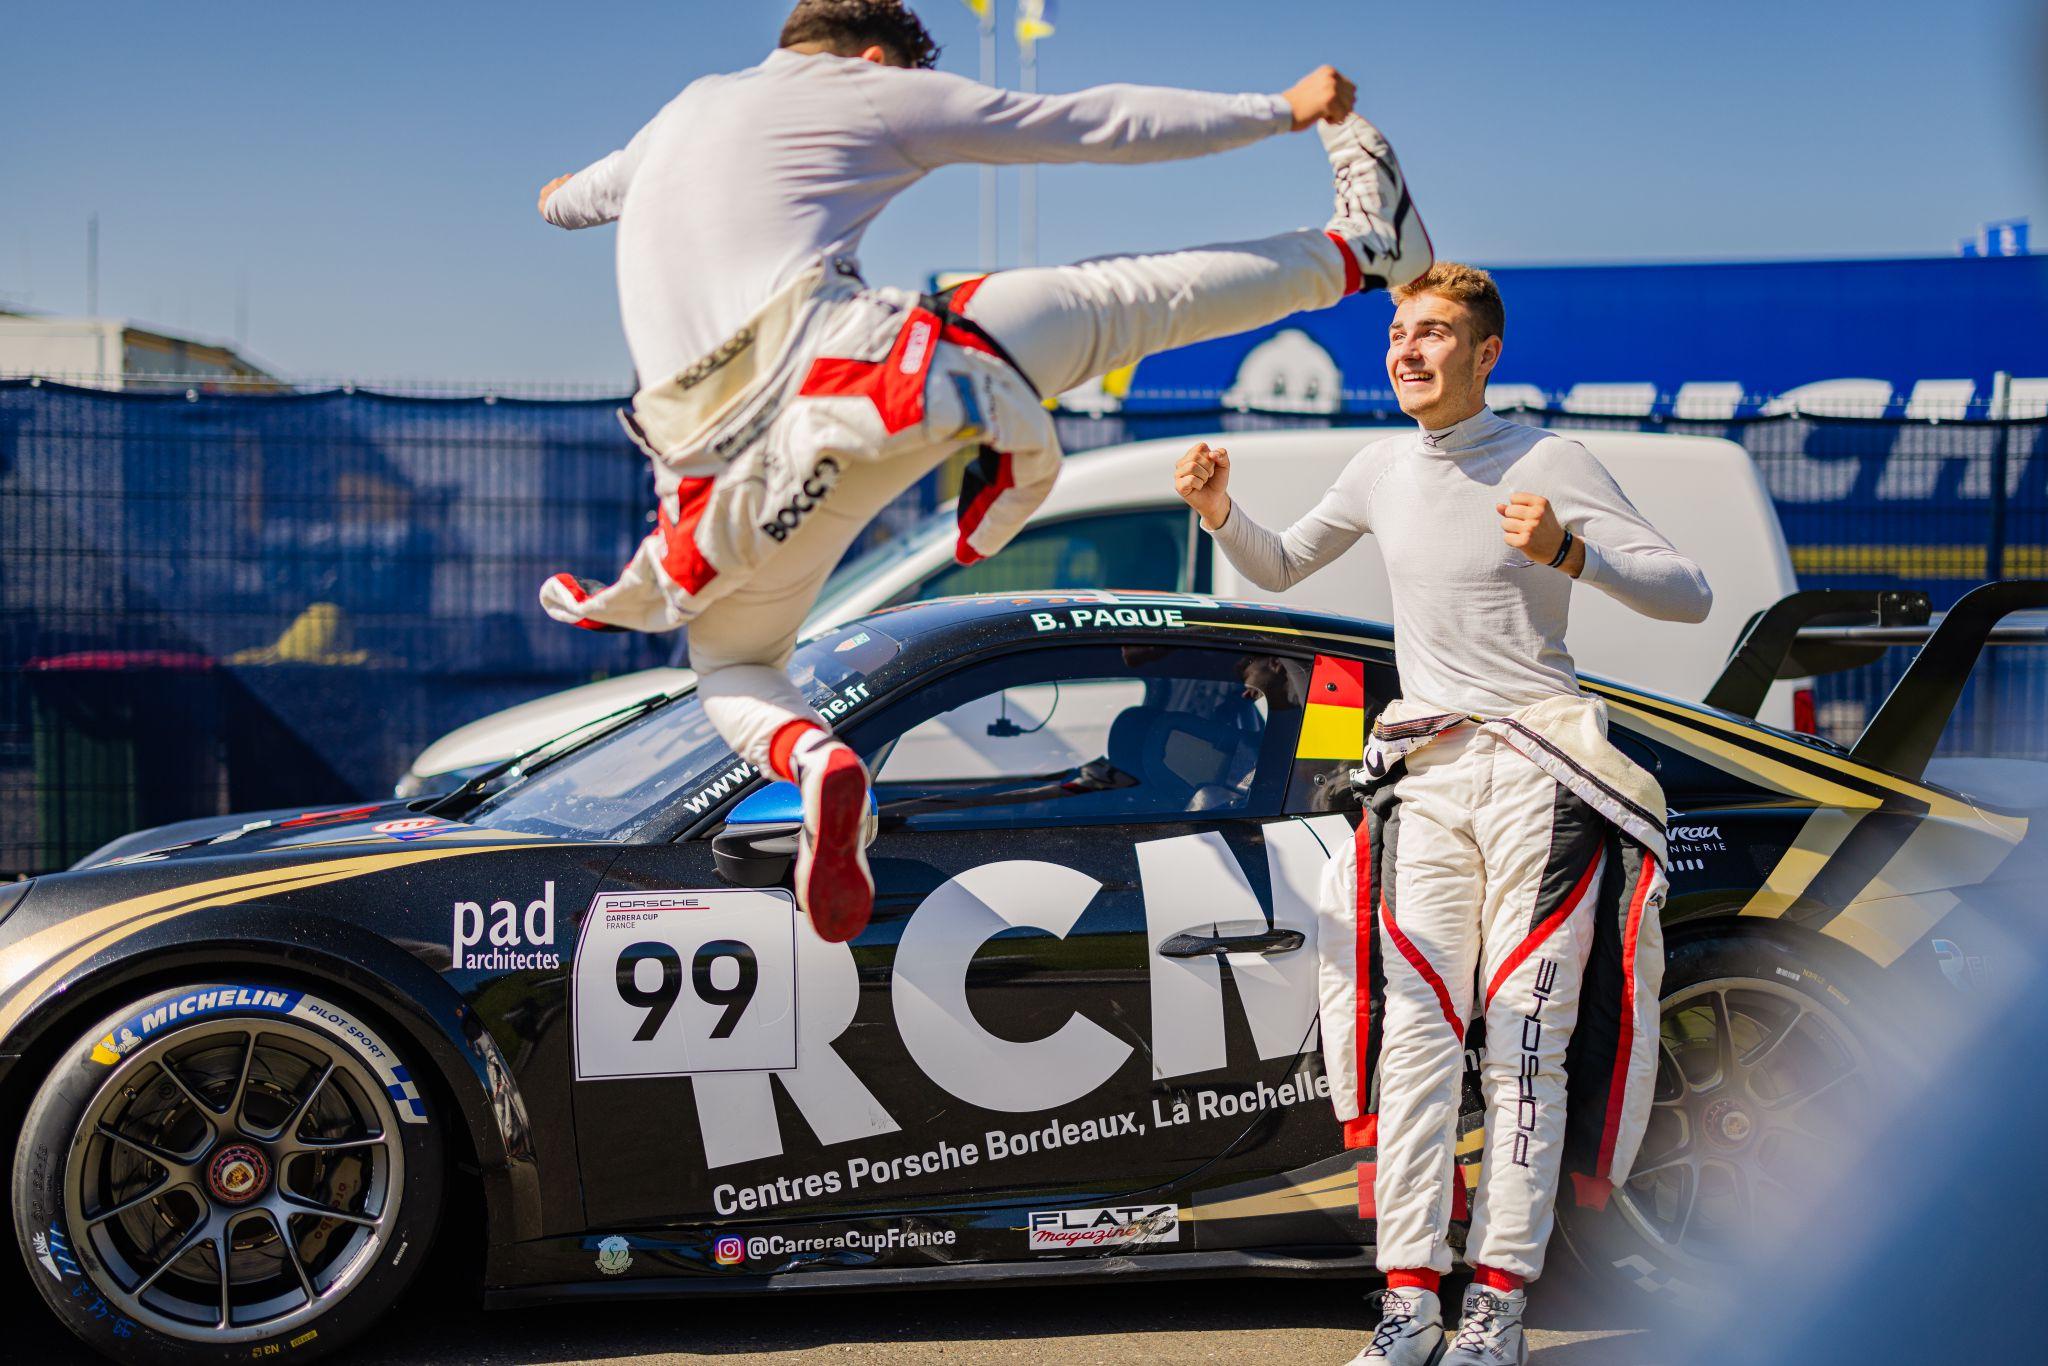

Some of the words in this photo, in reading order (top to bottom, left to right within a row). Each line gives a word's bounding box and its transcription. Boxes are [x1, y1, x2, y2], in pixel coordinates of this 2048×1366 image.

[1030, 612, 1066, 632] B.
[1071, 608, 1186, 629] PAQUE
[605, 899, 699, 909] PORSCHE
[606, 914, 642, 922] CARRERA
[642, 913, 659, 921] CUP
[453, 880, 555, 969] pad
[606, 922, 636, 930] FRANCE
[466, 947, 560, 970] architectes
[615, 938, 760, 1042] 99
[141, 988, 289, 1034] MICHELIN
[308, 1004, 344, 1027] PILOT
[348, 1025, 387, 1060] SPORT
[1512, 957, 1558, 1168] PORSCHE
[712, 1169, 842, 1216] Centres
[847, 1141, 979, 1189] Porsche
[985, 1109, 1146, 1161] Bordeaux,
[1152, 1097, 1191, 1129] La
[747, 1228, 956, 1260] @CarreraCupFrance
[1032, 1226, 1138, 1246] magazine
